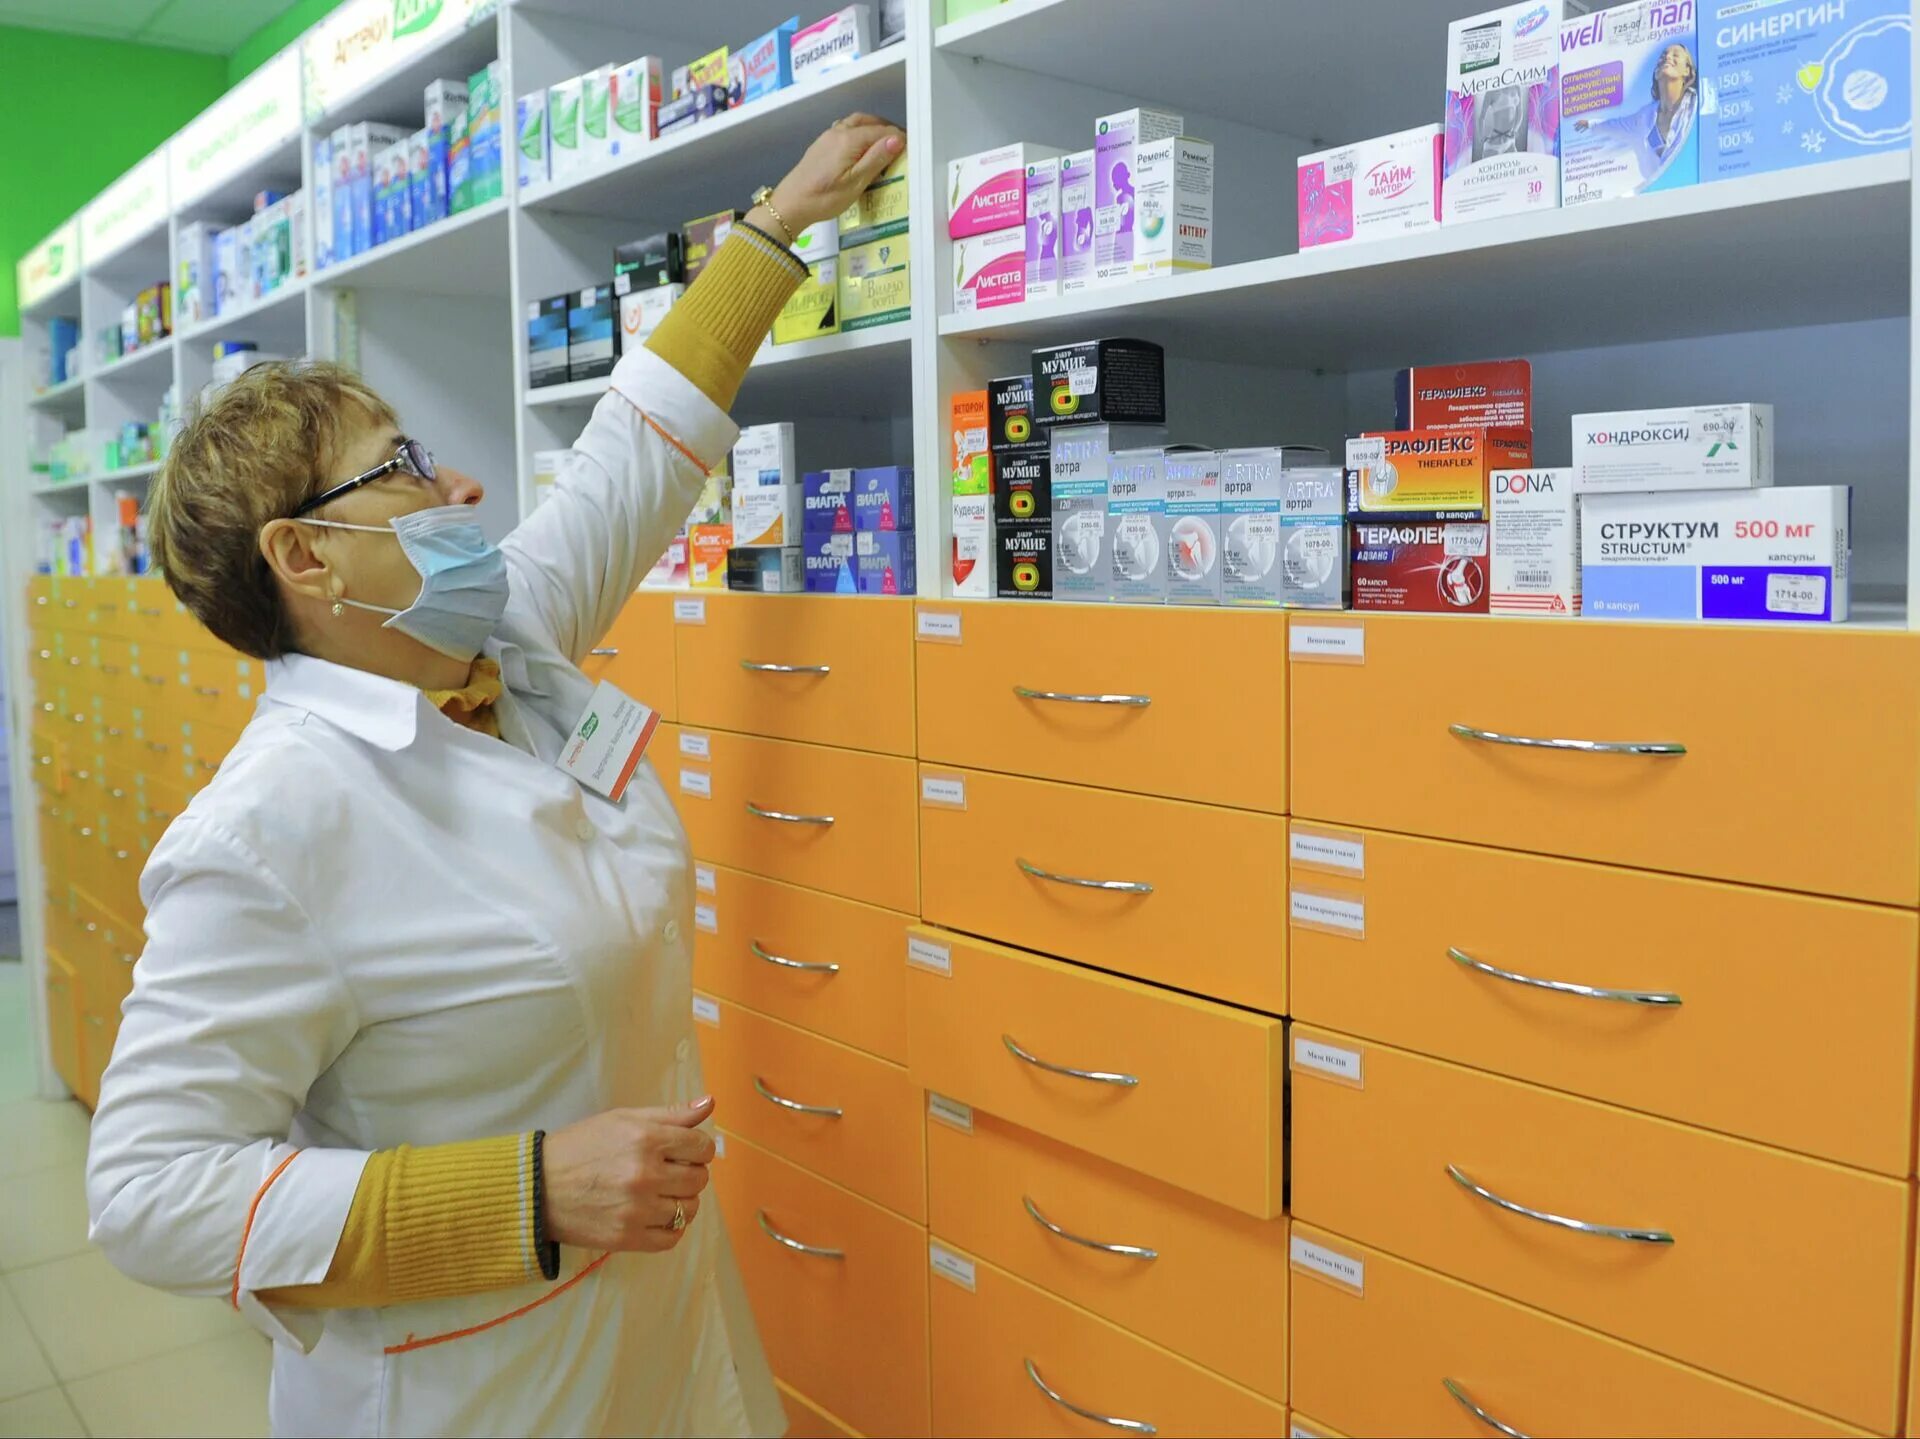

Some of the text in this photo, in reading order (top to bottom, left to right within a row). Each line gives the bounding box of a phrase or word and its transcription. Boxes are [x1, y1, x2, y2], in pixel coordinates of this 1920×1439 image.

[1716, 0, 1844, 48] СИНЕРГИН
[794, 31, 854, 70] БРИЗАНТИН
[1527, 180, 1542, 195] 30
[972, 188, 1020, 211] Листата
[976, 270, 1022, 289] Листата
[1041, 355, 1087, 375] МУМИЕ
[996, 390, 1034, 405] МУМИЕ
[1418, 386, 1487, 401] ТЕРАФЛЕКС
[1384, 436, 1475, 456] ЕРАФЛЕКС
[1054, 462, 1080, 476] артра
[1417, 458, 1473, 468] THERAFLEX
[1002, 465, 1041, 480] МУМИЕ
[1112, 483, 1136, 497] артра
[1225, 482, 1252, 496] артра
[1496, 474, 1554, 494] DONA
[856, 489, 890, 507] ВИАГРА
[1167, 490, 1185, 500] артра
[1347, 472, 1359, 513] Health
[805, 494, 847, 509] ВИАГРА
[1286, 499, 1312, 511] артра
[954, 503, 986, 520] Кудесан
[1436, 511, 1475, 520] 60 капсул
[1357, 525, 1446, 545] ТЕРАФЛЕК
[1600, 522, 1719, 540] СТРУКТУМ
[1735, 521, 1816, 539] 500 мг
[1005, 538, 1047, 551] МУМИЕ
[1601, 542, 1686, 554] STRUCTUM
[806, 555, 850, 569] ВИАГРА
[1768, 553, 1816, 563] капсулы
[1357, 578, 1367, 586] 60
[1711, 575, 1745, 586] 500 мг
[1775, 589, 1813, 600] 1714-00
[1593, 601, 1640, 612] 60 капсул
